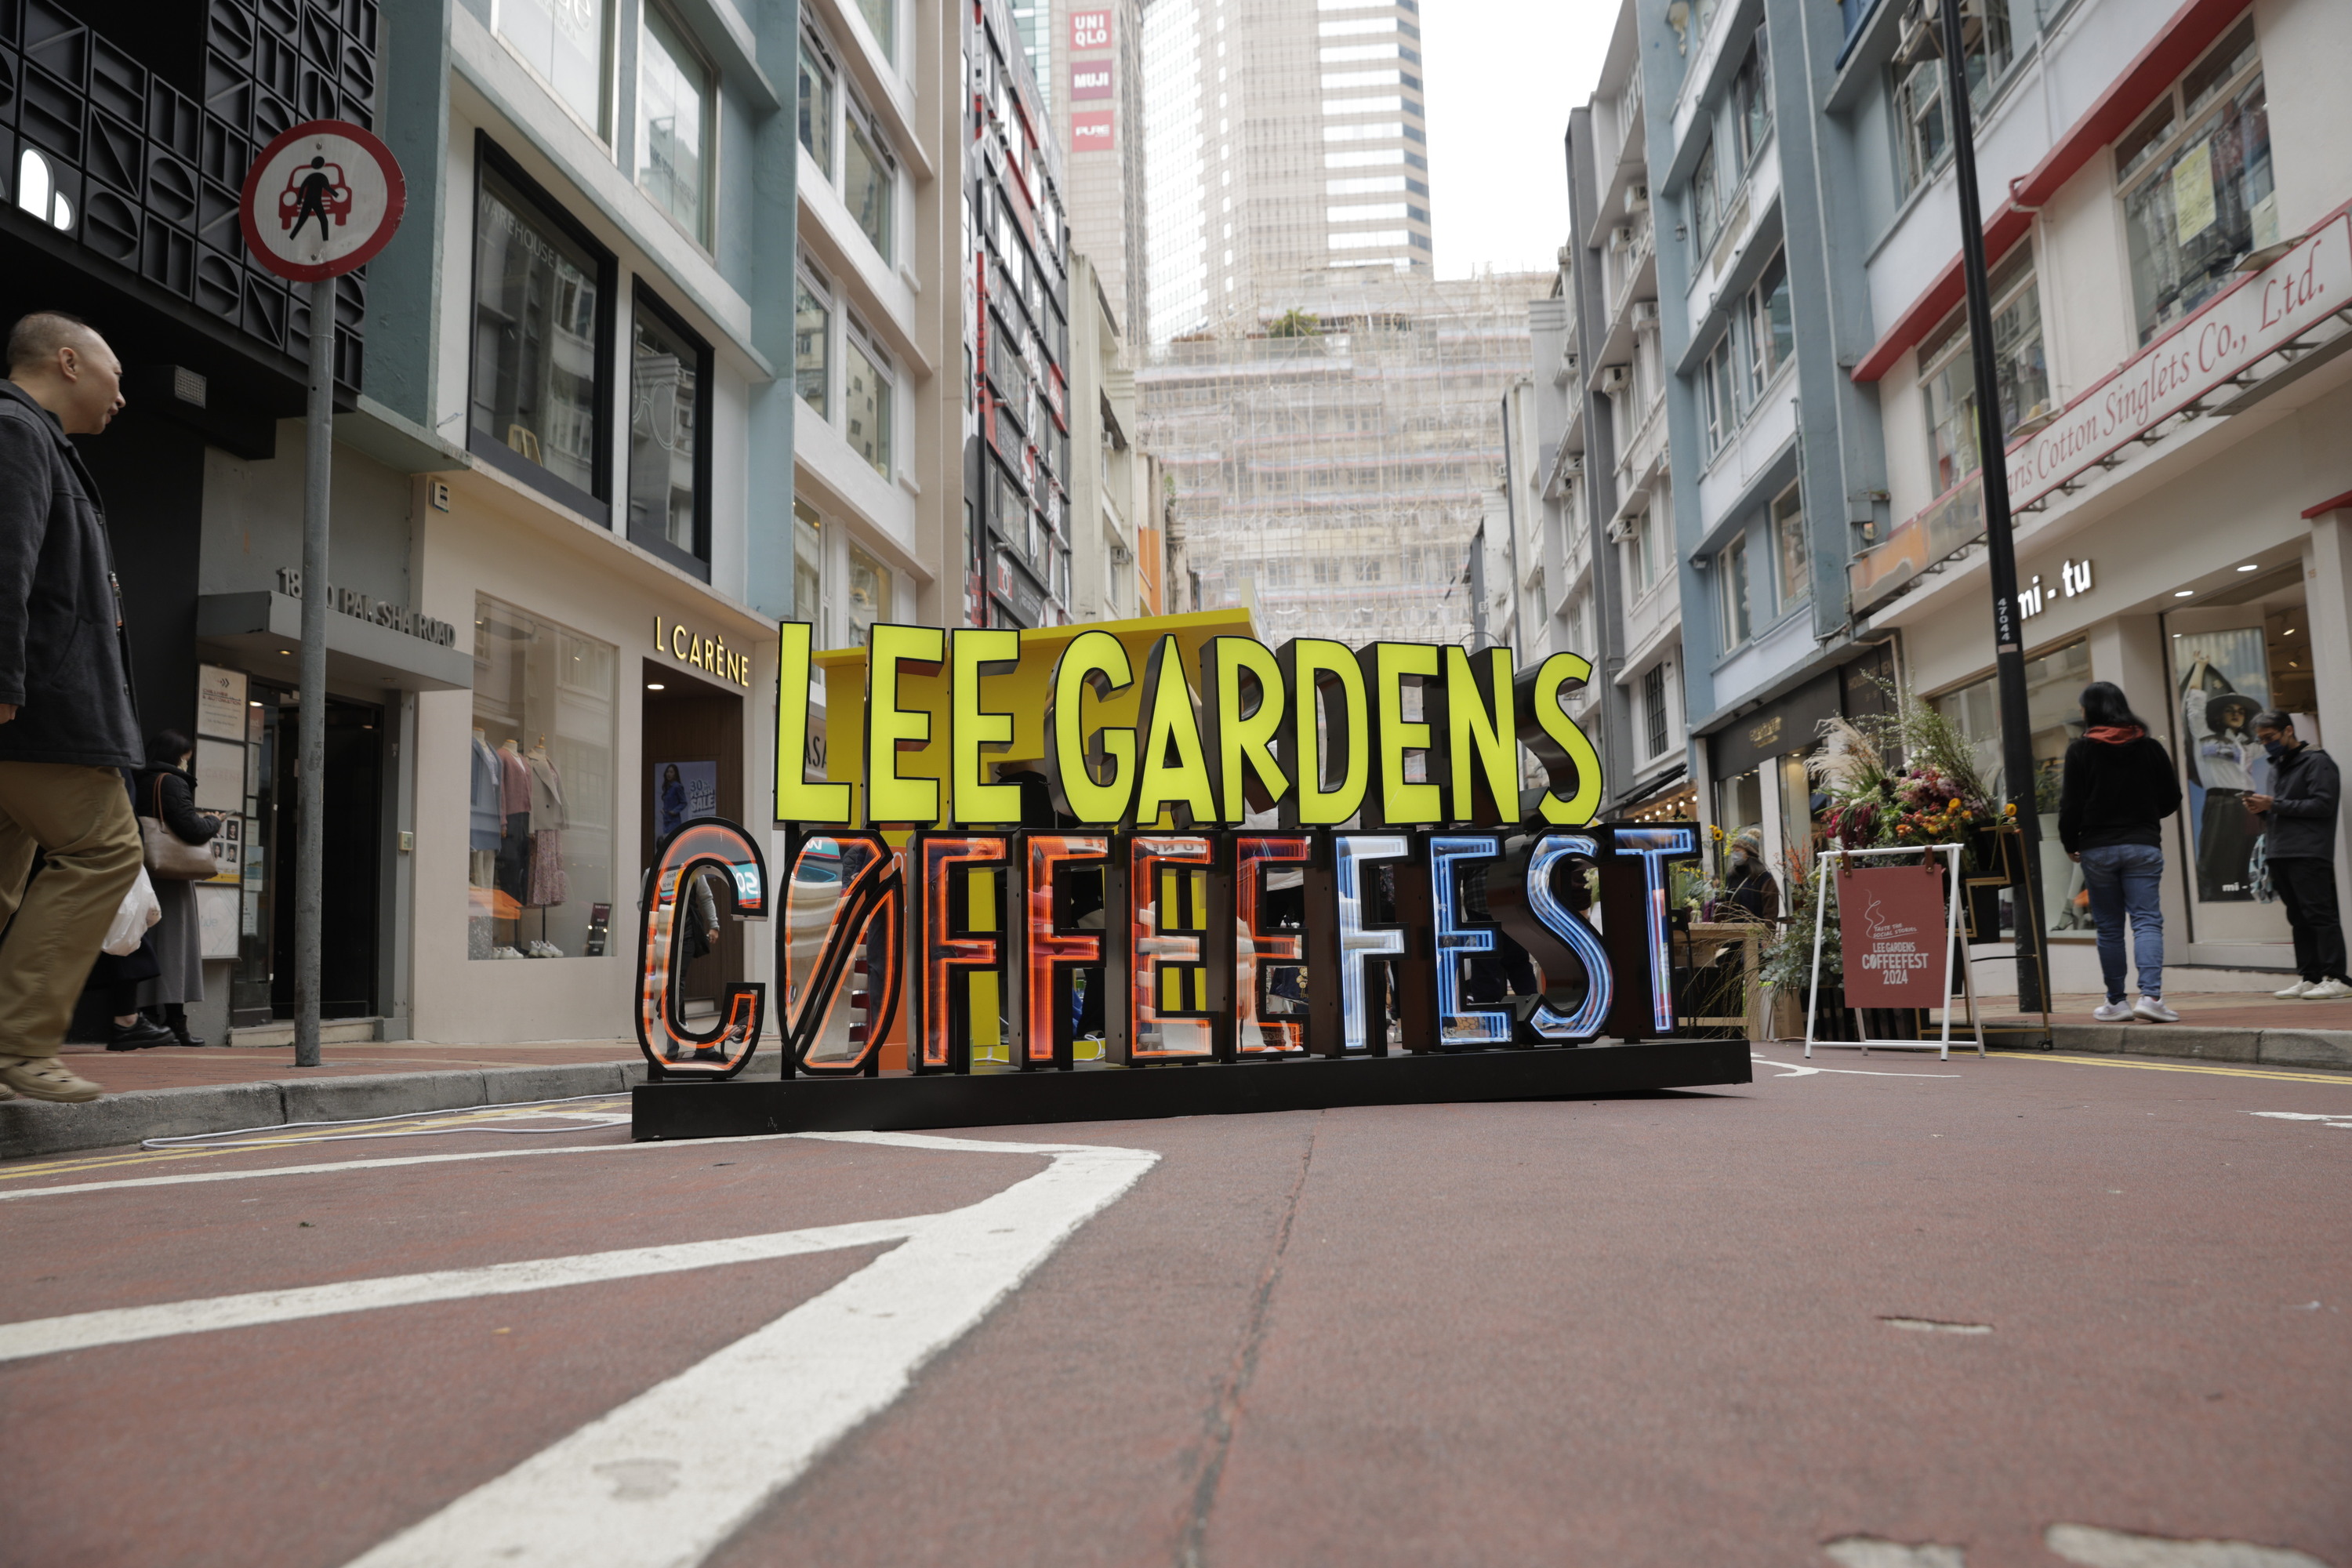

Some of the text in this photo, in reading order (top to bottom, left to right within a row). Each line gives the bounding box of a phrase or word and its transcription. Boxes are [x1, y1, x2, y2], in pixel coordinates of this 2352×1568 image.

[1074, 13, 1105, 30] UNI
[1075, 29, 1108, 47] QLO
[1074, 72, 1109, 89] MUJI
[1076, 124, 1110, 136] PURE
[481, 194, 554, 268] WAREHOUSE
[2037, 416, 2098, 481] Cotton
[2103, 352, 2190, 437] Singlets
[2198, 322, 2248, 374] Co.,
[2259, 238, 2325, 332] Ltd.
[339, 588, 376, 623] PAK
[376, 601, 414, 635] SHA
[414, 613, 456, 648] ROAD
[1998, 597, 2010, 641] 47044
[654, 616, 750, 688] L CARÈNE
[775, 621, 1604, 828] LEE GARDENS
[690, 795, 715, 813] SALE
[1872, 942, 1916, 953] LEE GARDENS
[1882, 969, 1908, 985] 2024
